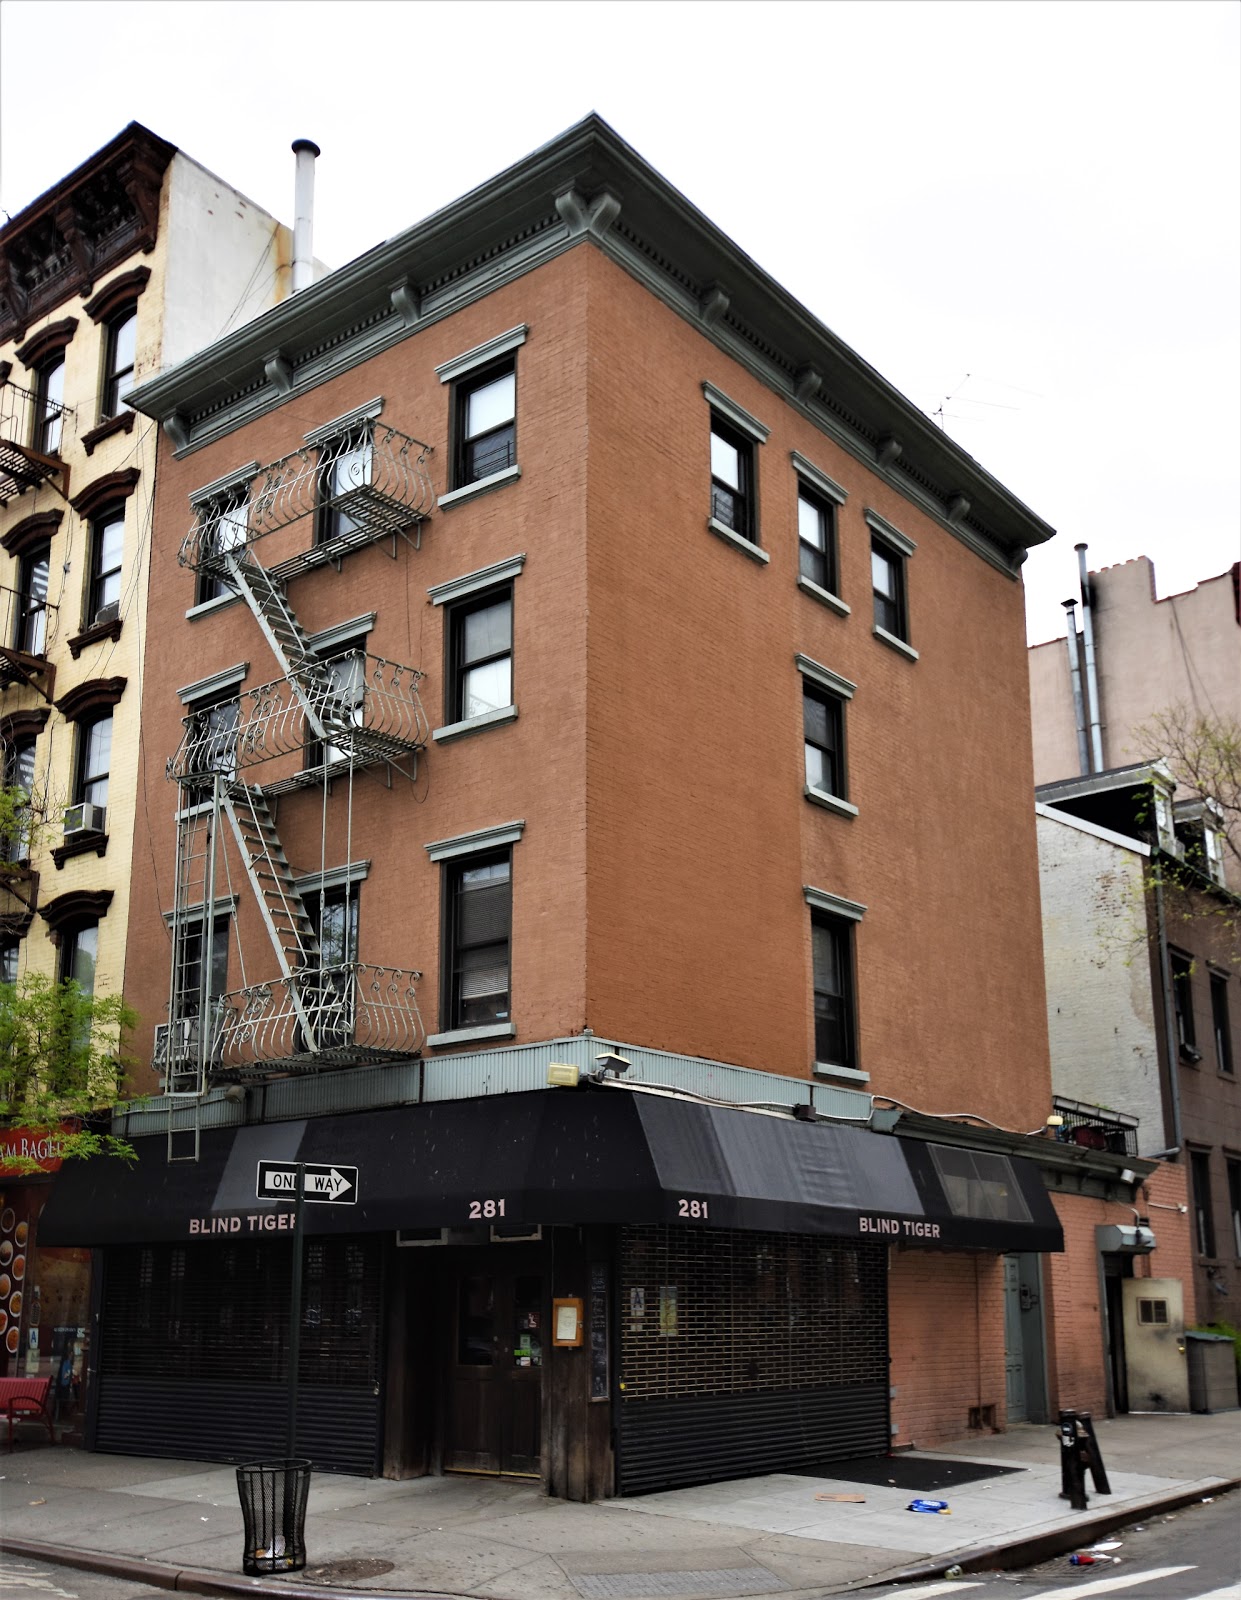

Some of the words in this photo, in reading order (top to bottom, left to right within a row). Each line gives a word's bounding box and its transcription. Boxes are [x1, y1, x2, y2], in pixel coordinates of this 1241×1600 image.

[273, 1174, 297, 1189] ON
[315, 1177, 342, 1191] WAY
[468, 1199, 505, 1219] 281
[678, 1199, 708, 1219] 281
[189, 1217, 241, 1234] BLIND
[859, 1217, 900, 1234] BLIND
[903, 1221, 940, 1238] TIGER
[632, 1290, 643, 1309] A
[30, 1330, 37, 1343] A
